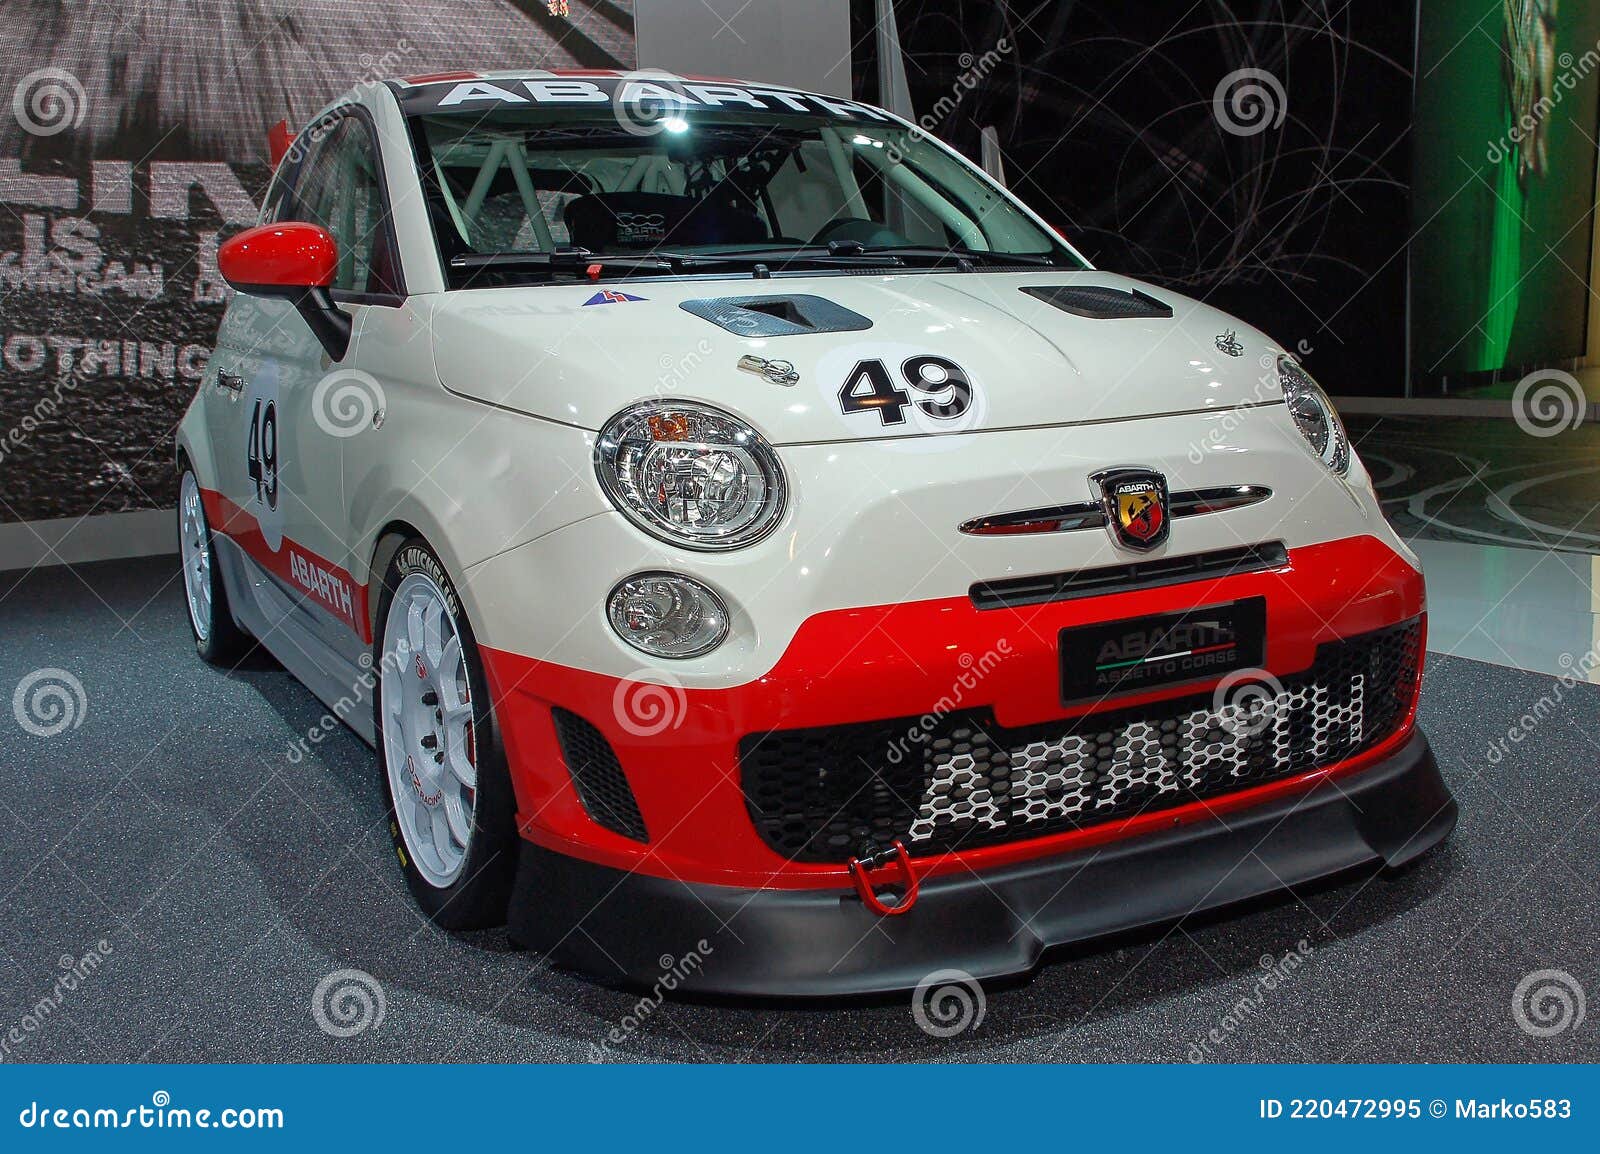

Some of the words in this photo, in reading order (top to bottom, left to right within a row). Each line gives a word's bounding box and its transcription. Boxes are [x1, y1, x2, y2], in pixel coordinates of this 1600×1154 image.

[438, 80, 889, 121] ABARTH
[837, 354, 973, 426] 49
[248, 397, 279, 512] 49
[1118, 483, 1154, 493] ABARTH
[289, 550, 354, 618] ABARTH
[1096, 621, 1236, 664] ABARTH
[1096, 661, 1176, 685] ASSETTO
[1182, 650, 1238, 671] CORSE
[908, 674, 1365, 841] ABARTH
